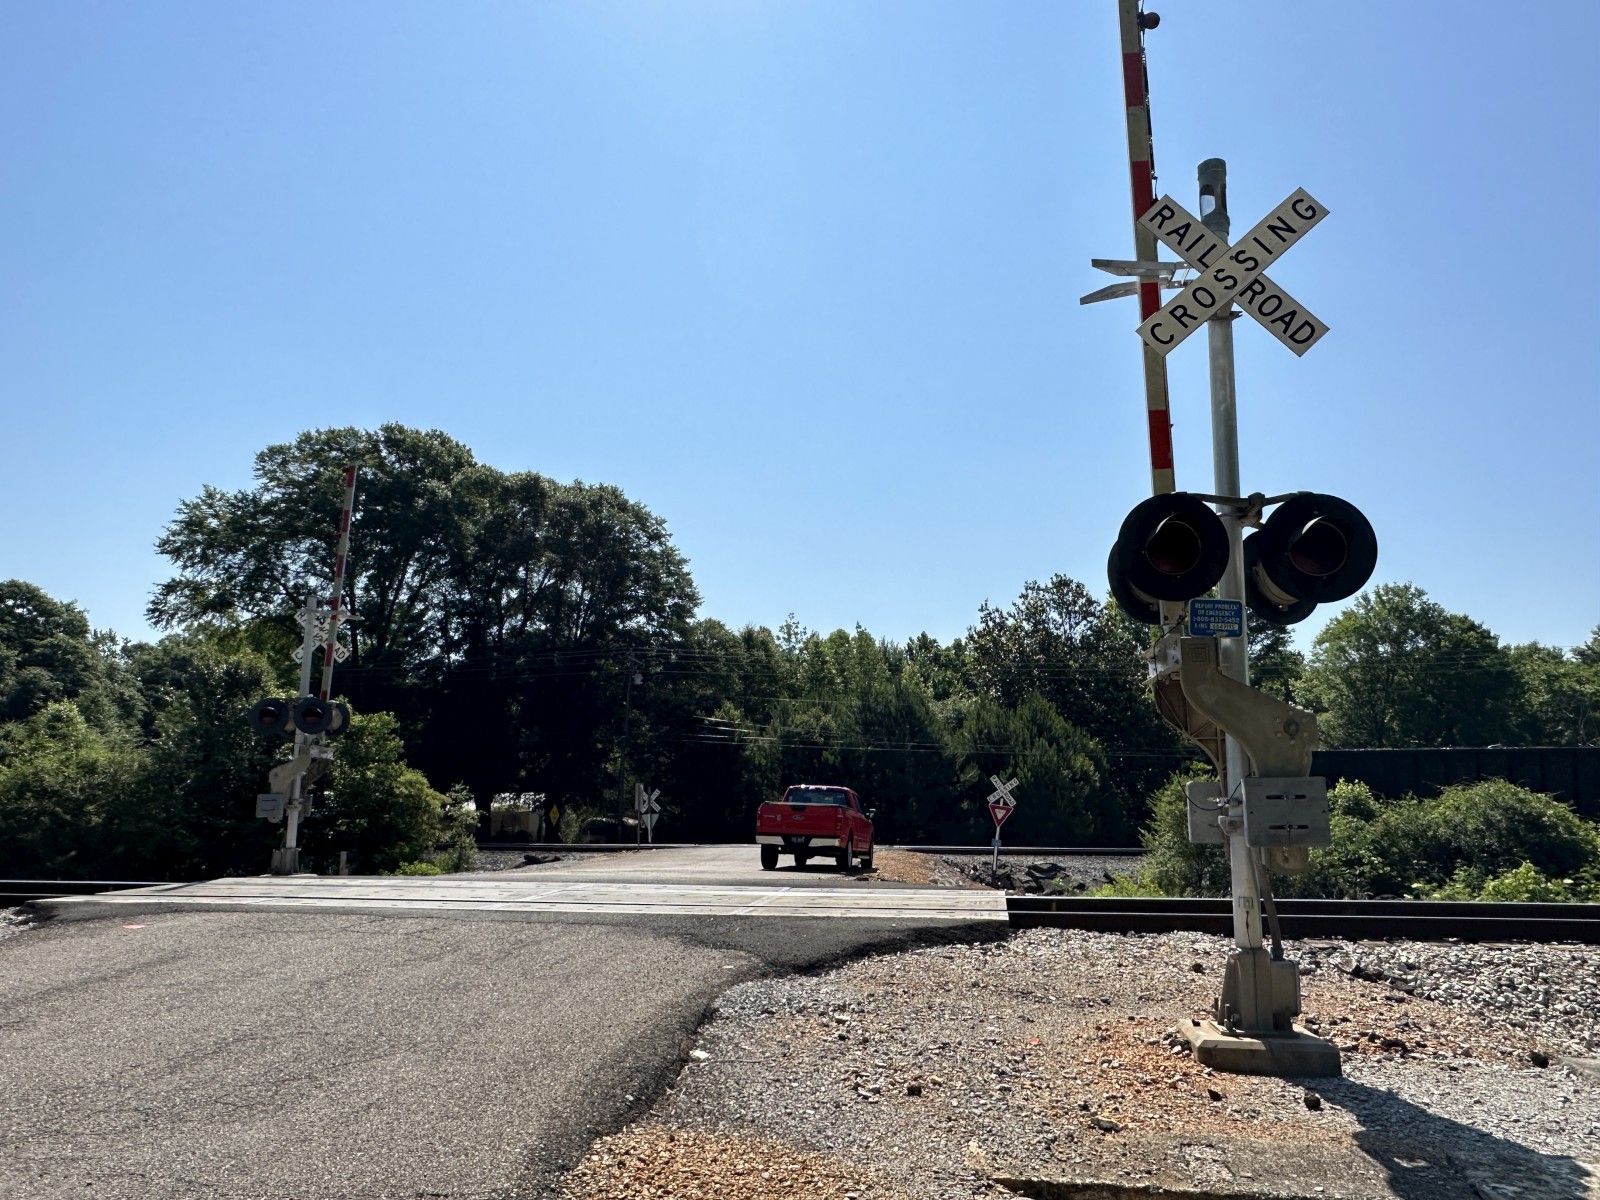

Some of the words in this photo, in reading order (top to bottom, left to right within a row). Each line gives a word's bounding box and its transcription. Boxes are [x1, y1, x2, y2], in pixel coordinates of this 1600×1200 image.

[1148, 203, 1217, 269] RAIL
[1239, 277, 1316, 345] ROAD
[1149, 198, 1317, 345] CROSSING
